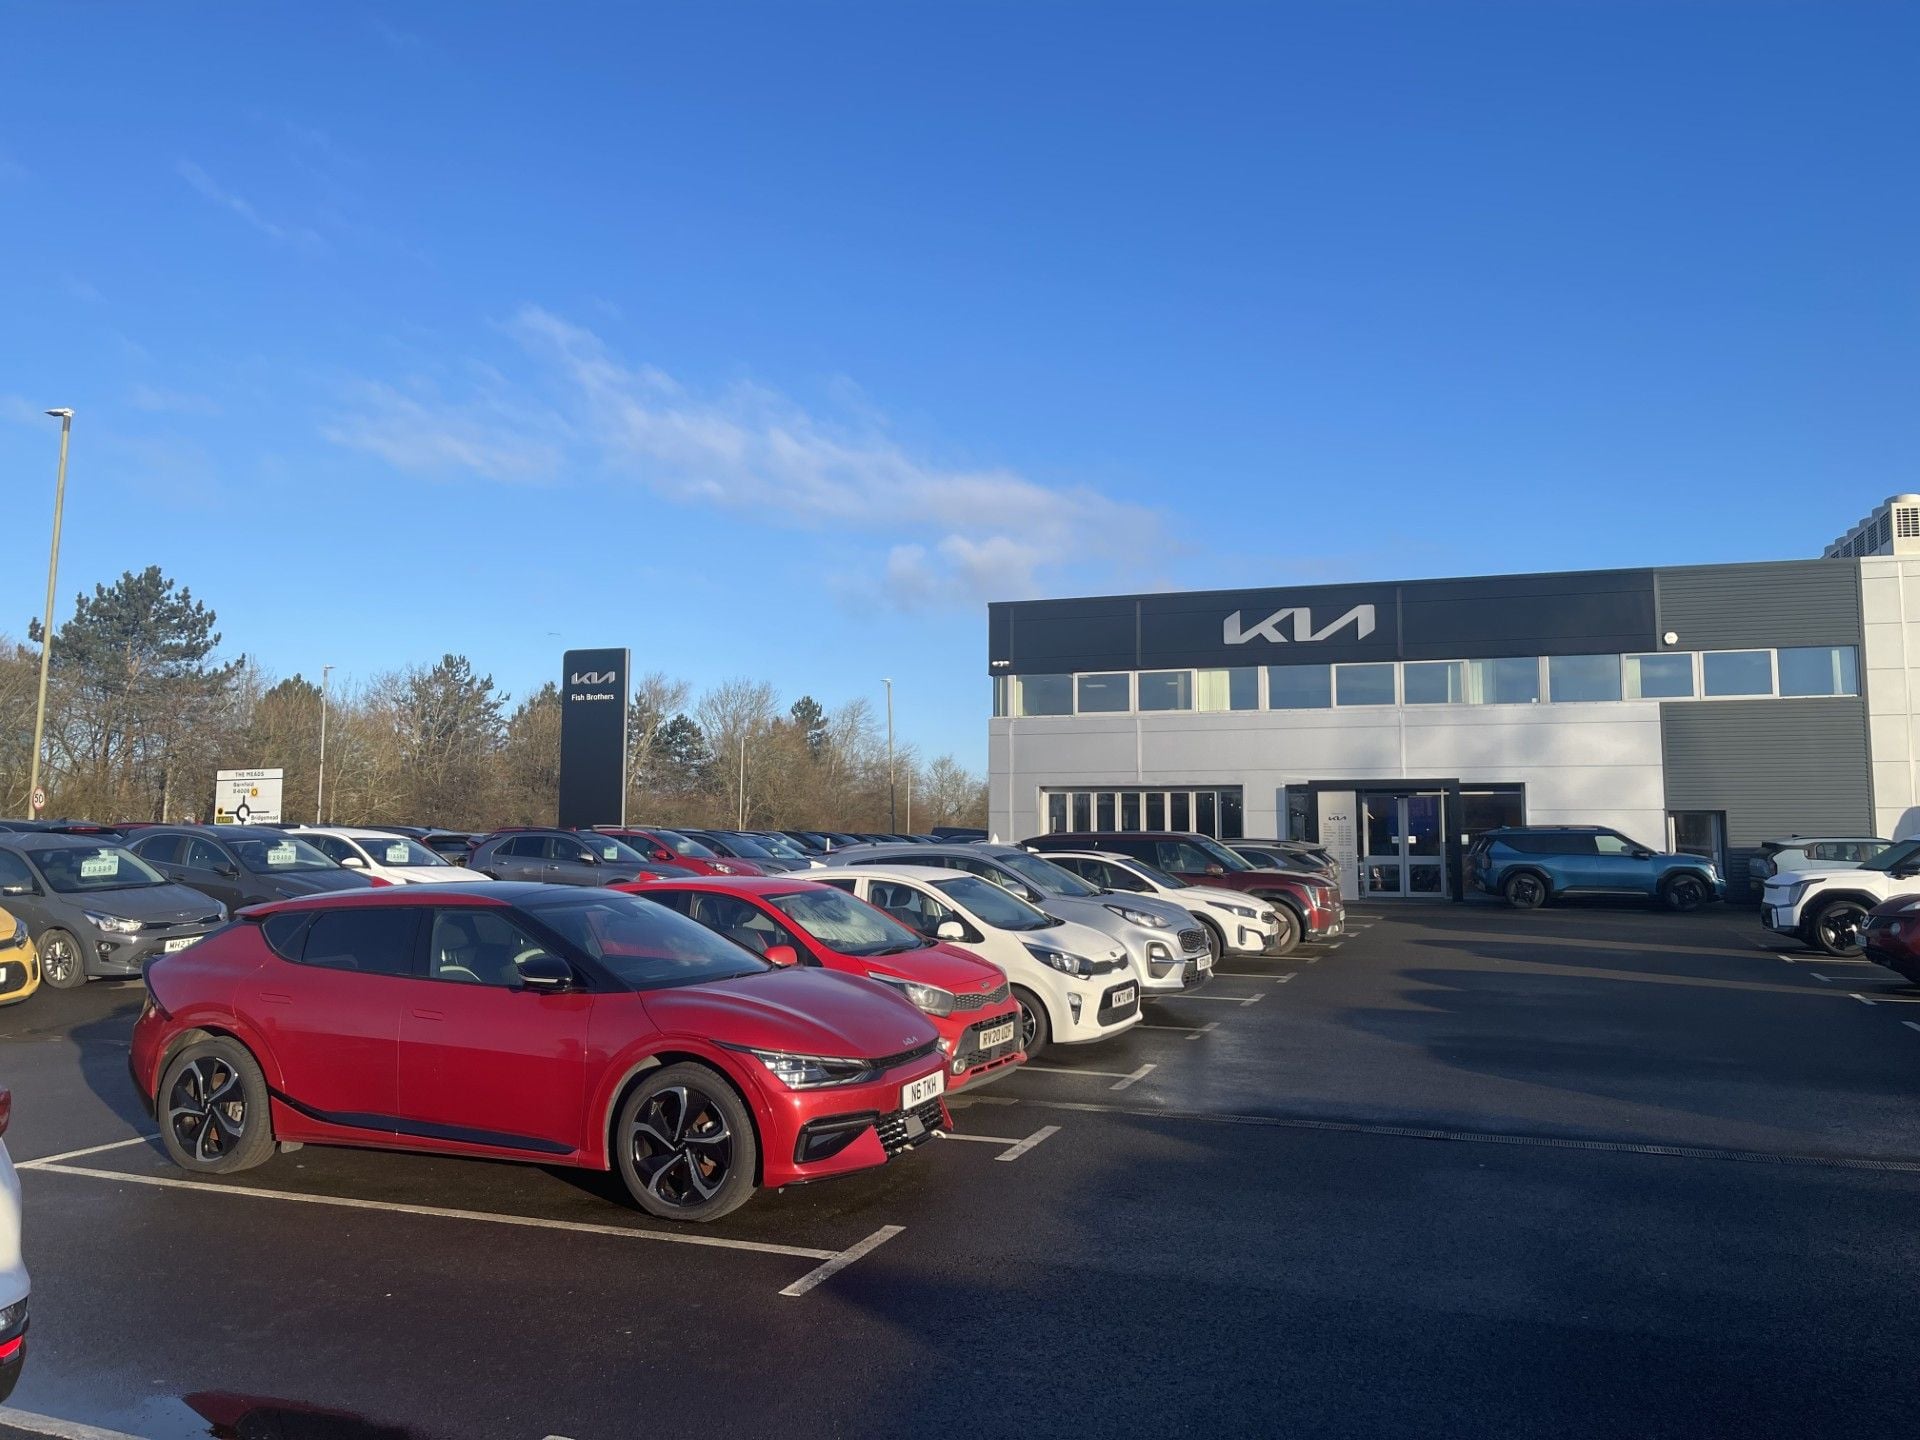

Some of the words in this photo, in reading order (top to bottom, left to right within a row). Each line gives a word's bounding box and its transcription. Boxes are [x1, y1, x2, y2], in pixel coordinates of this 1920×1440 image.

[1223, 604, 1376, 645] KIA
[571, 671, 616, 685] KIA
[571, 693, 585, 701] Fish
[34, 794, 44, 804] 50
[982, 1027, 1001, 1047] RV20
[911, 1083, 921, 1103] N6
[923, 1076, 937, 1098] TKH
